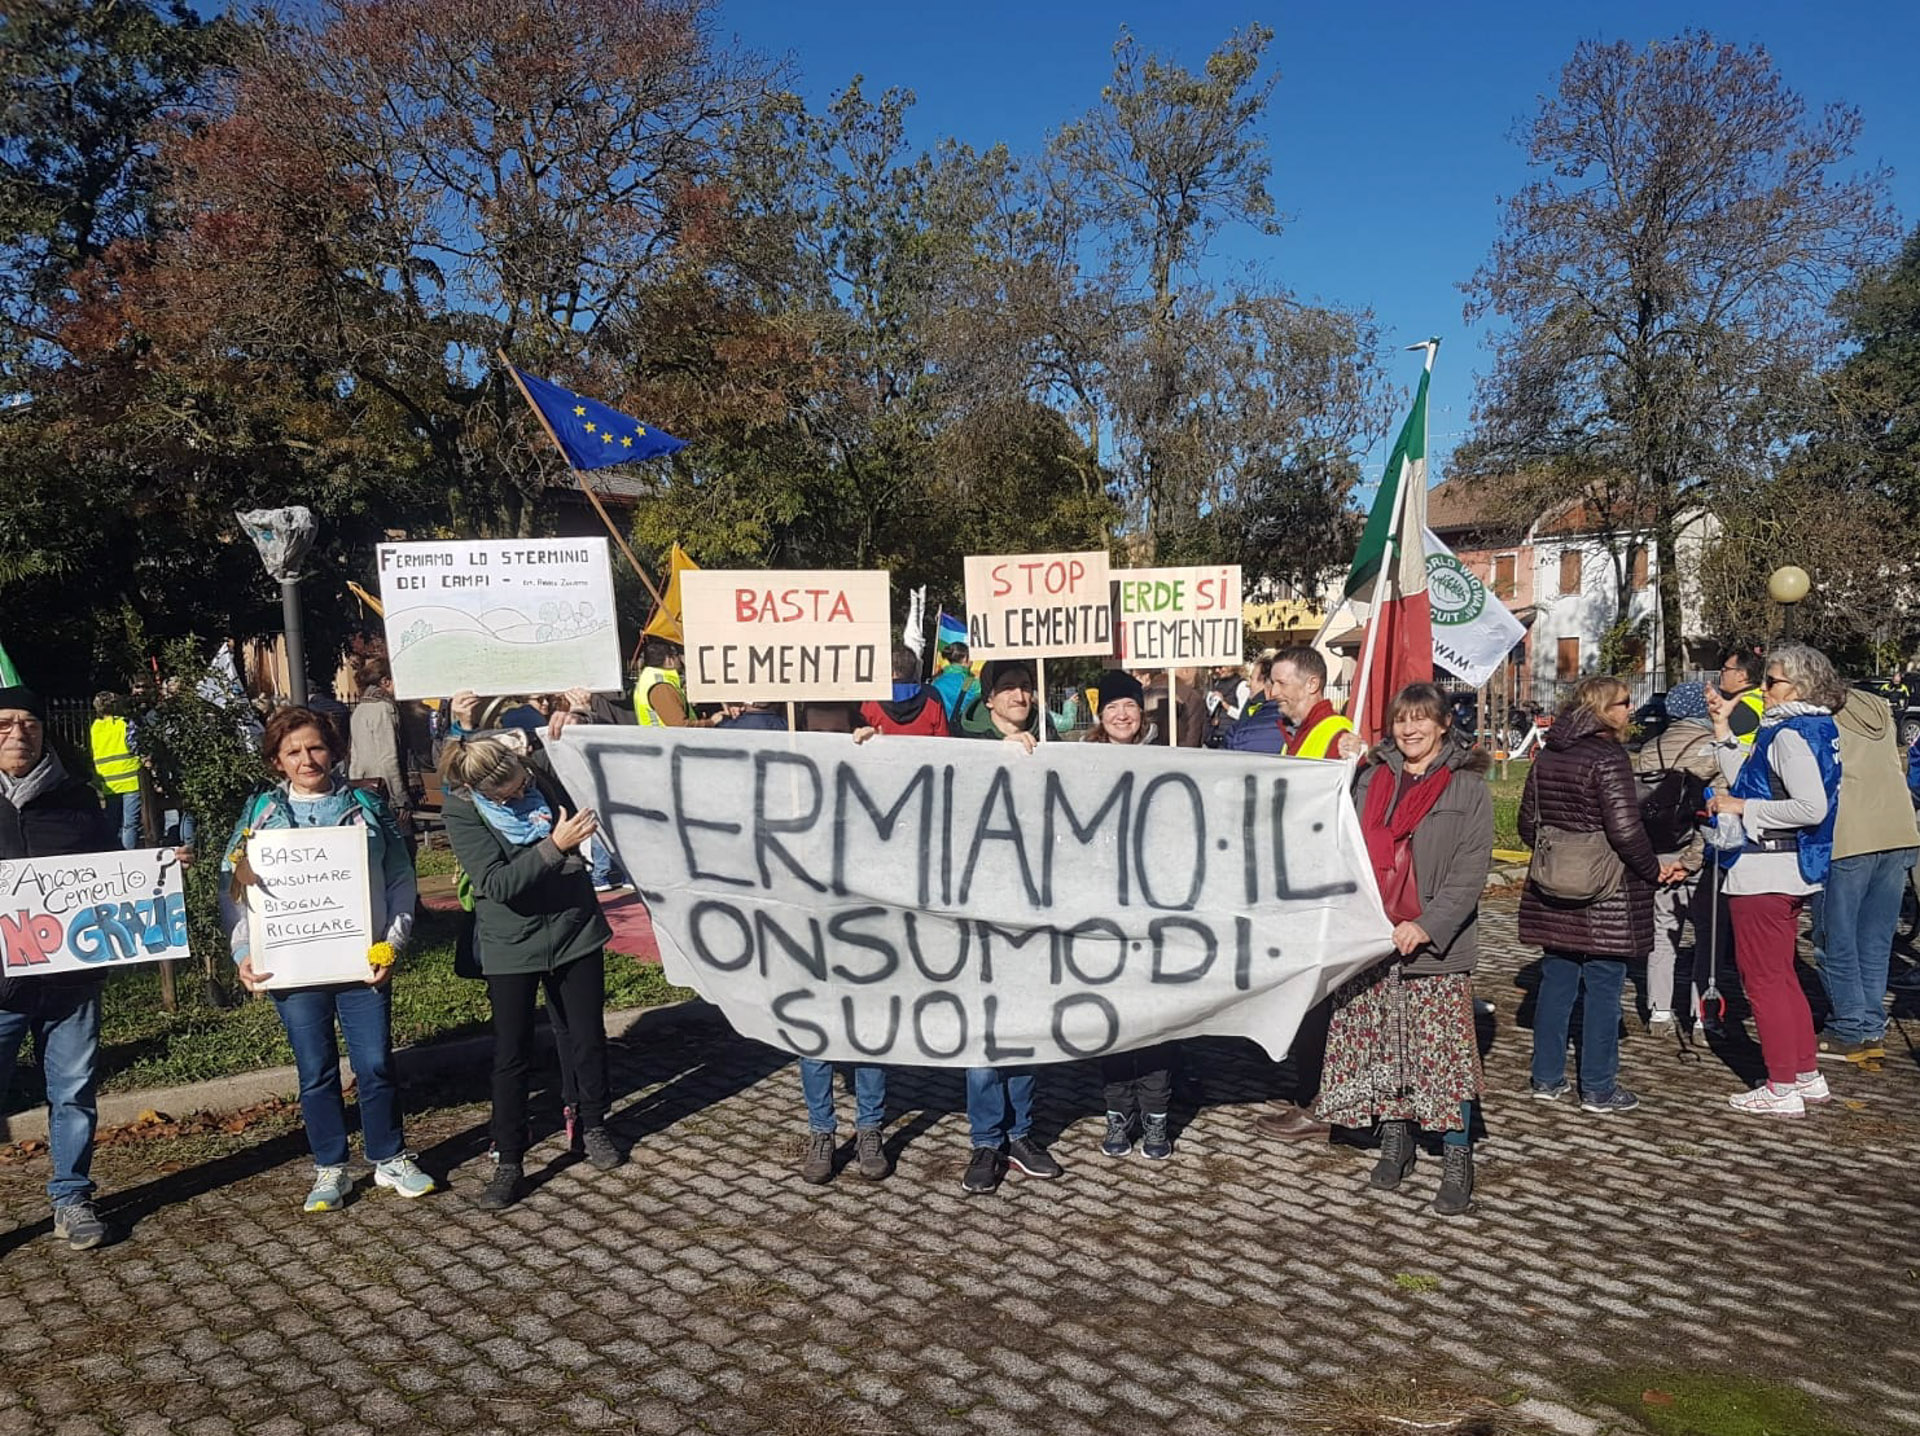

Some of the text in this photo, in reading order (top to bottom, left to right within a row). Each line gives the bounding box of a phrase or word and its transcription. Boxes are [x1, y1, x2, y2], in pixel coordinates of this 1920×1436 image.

[381, 548, 589, 572] FERMIAMO LO STERMINIO
[1425, 555, 1456, 574] ORLD
[397, 575, 426, 590] DEI
[442, 574, 490, 588] CAMPI
[991, 560, 1085, 597] STOP
[735, 588, 855, 623] BASTA
[1429, 608, 1461, 623] CUIT
[970, 604, 1111, 648] AL CEMENTO
[1133, 617, 1238, 659] CEMENTO
[699, 644, 875, 684] CEMENTO
[586, 743, 1358, 911] FERMIAMO IL
[261, 847, 328, 866] BASTA
[12, 863, 97, 896] Ancora
[264, 896, 336, 912] BISOGNA
[0, 887, 187, 967] NO GRAZIE
[266, 918, 355, 937] RICICLARE
[640, 889, 1128, 985] ONSUMO
[771, 989, 1120, 1060] SUOLO
